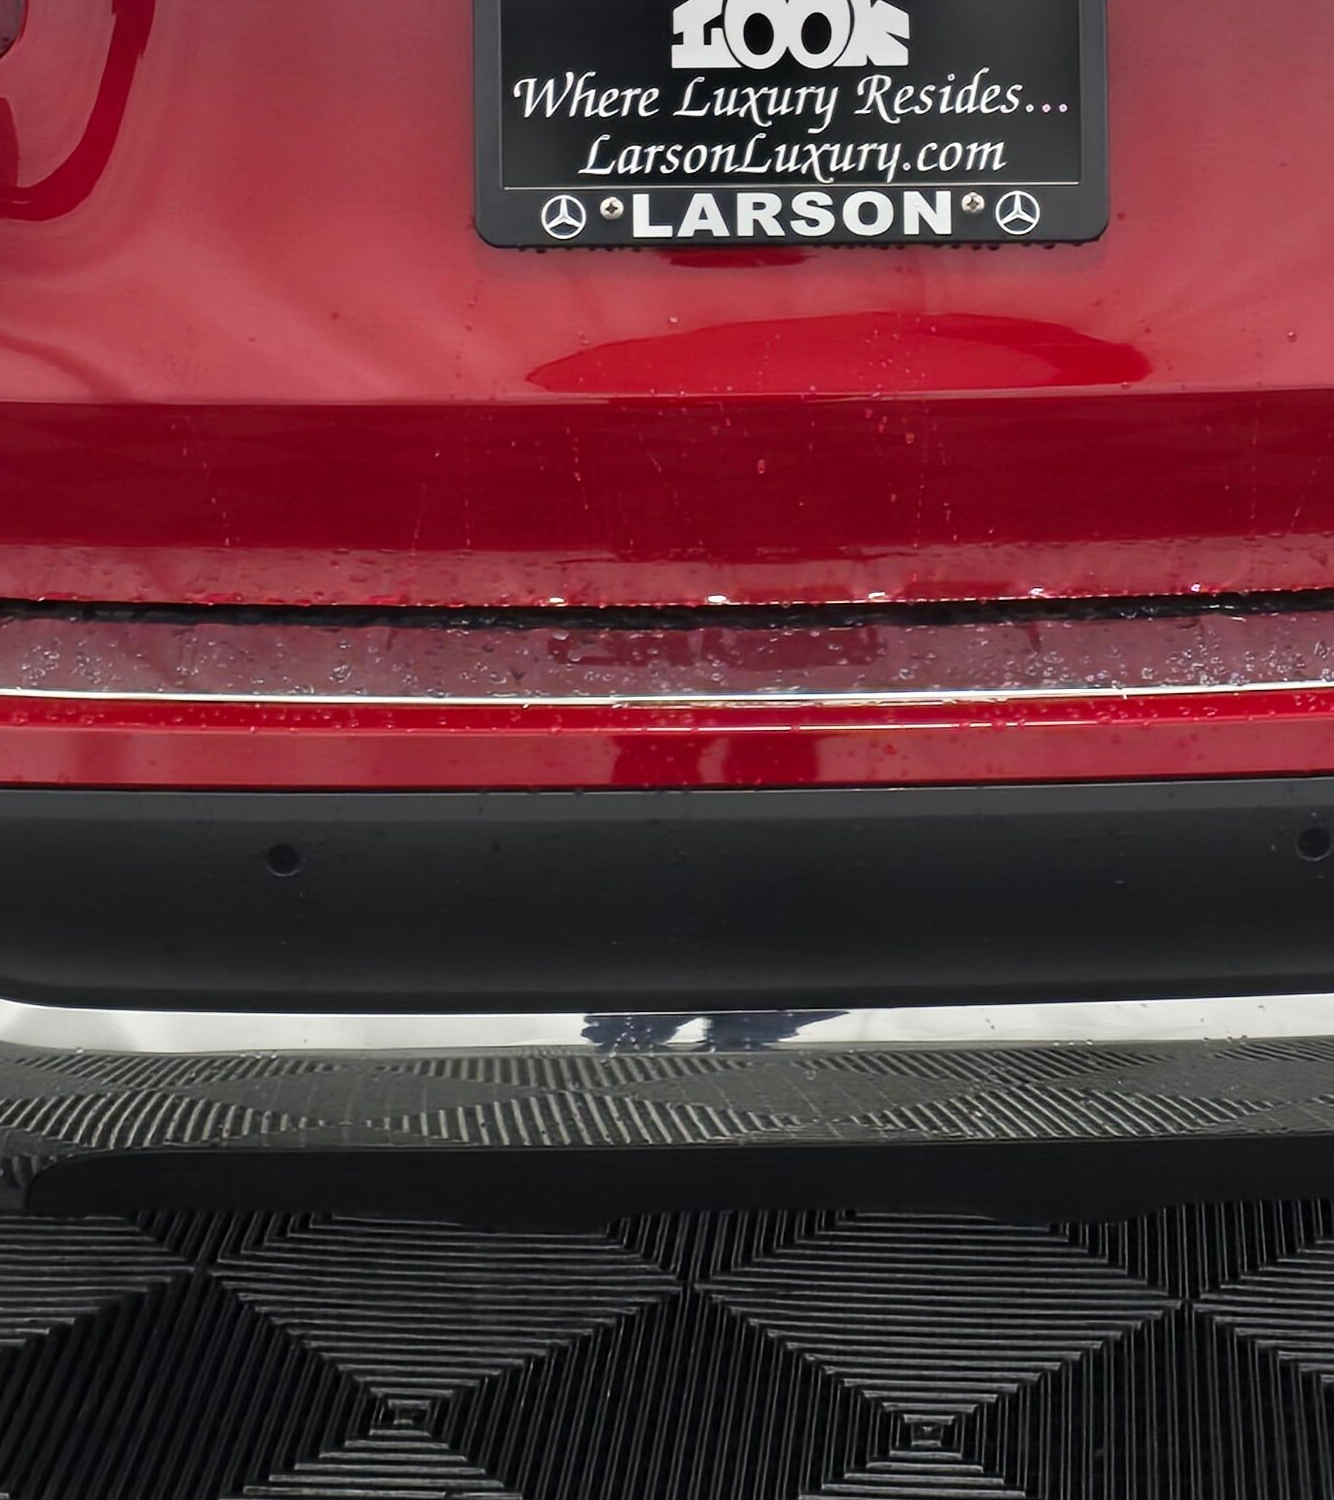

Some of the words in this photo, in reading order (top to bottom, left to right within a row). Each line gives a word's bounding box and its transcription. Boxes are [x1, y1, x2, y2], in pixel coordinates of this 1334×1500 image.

[513, 72, 660, 118] Where
[673, 76, 839, 134] Luxury
[854, 67, 1068, 124] Resides...
[578, 133, 1007, 184] LarsonLuxury.com
[632, 191, 952, 238] LARSON
